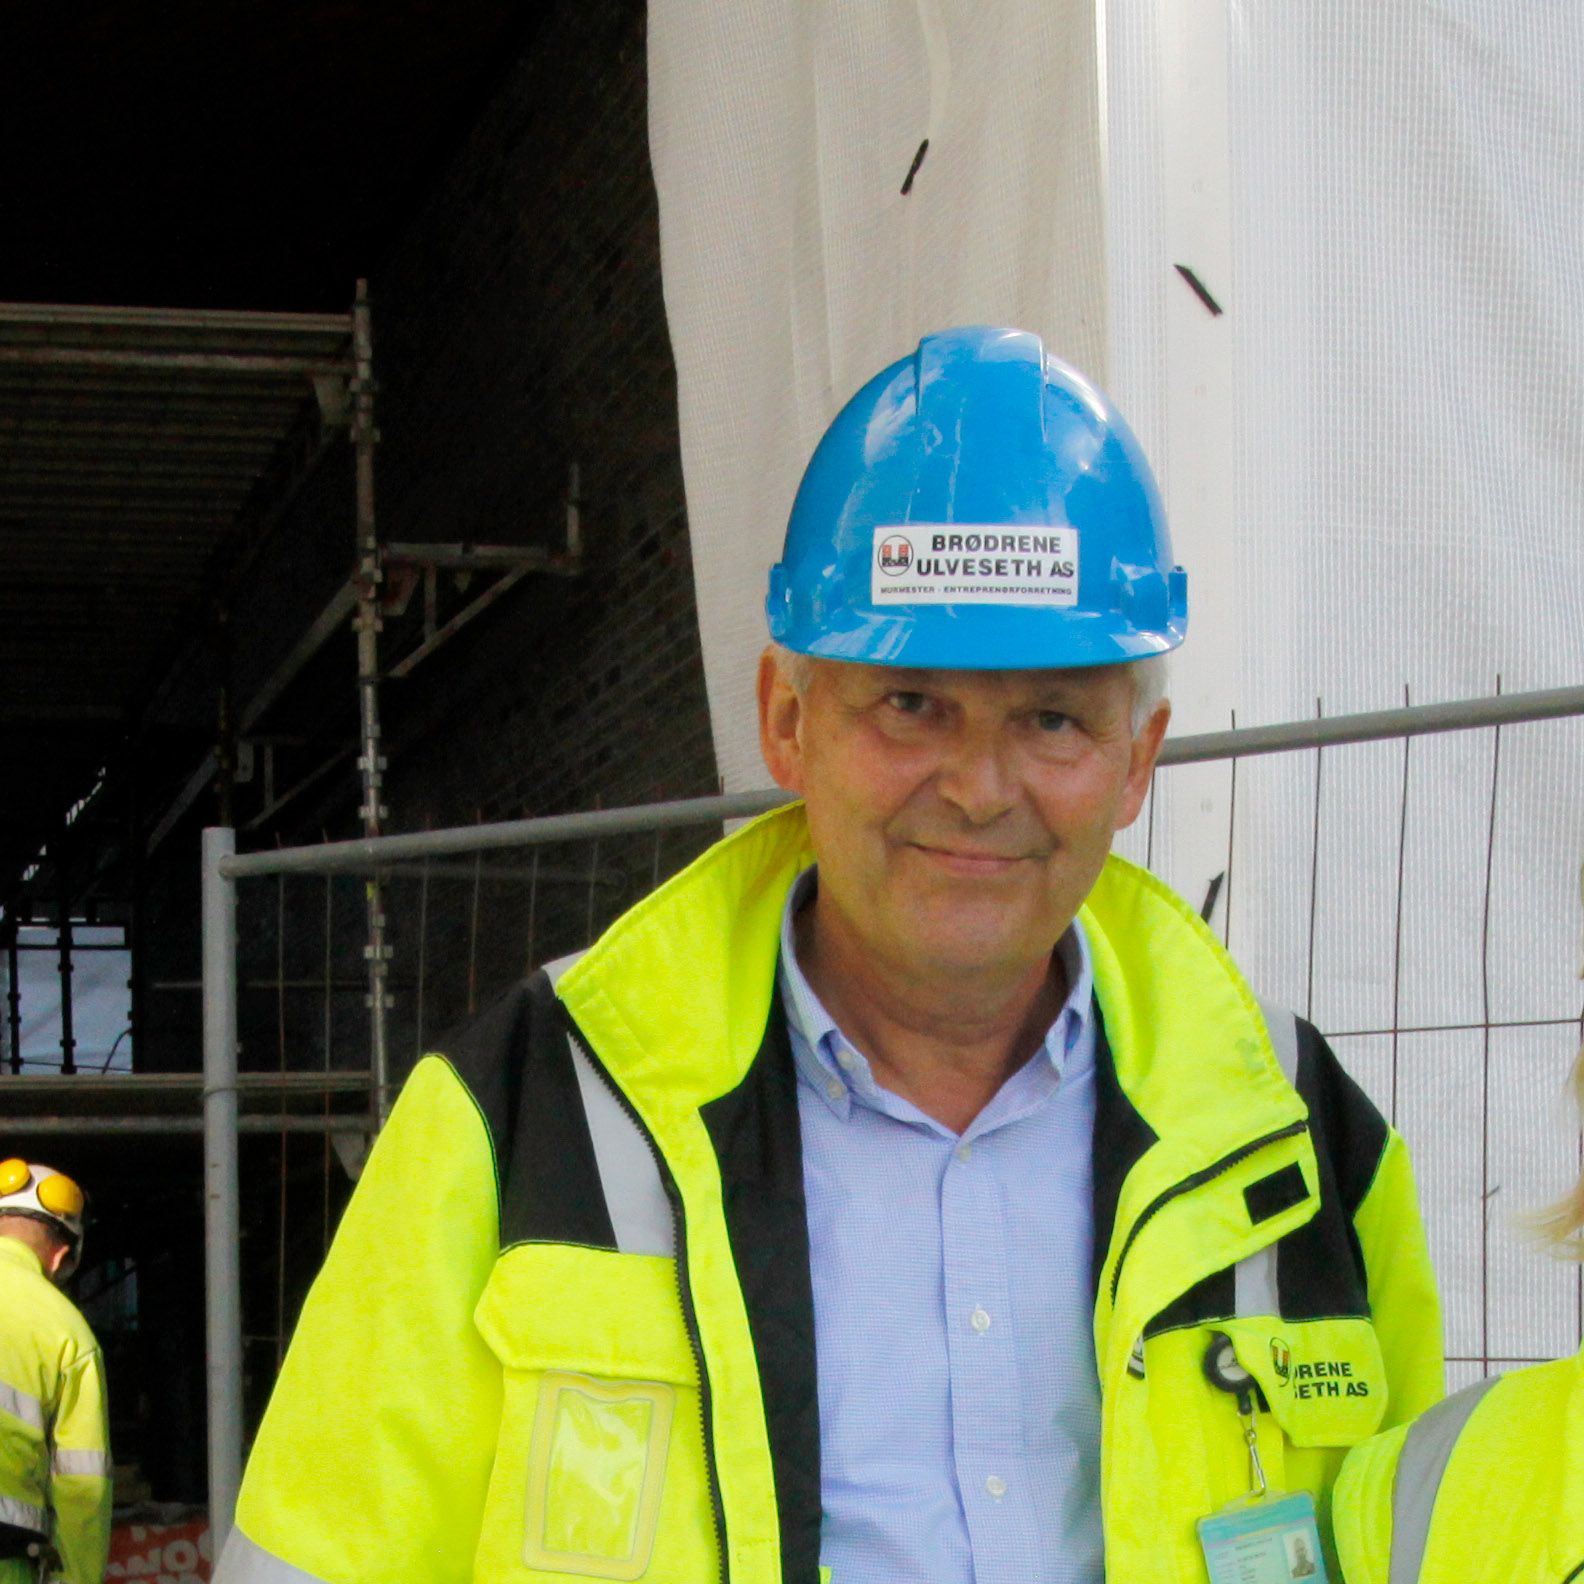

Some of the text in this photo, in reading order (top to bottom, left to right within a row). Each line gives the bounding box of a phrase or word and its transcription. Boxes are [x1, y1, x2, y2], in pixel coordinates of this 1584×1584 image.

[932, 534, 1062, 554] BRØDRENE
[916, 558, 1074, 578] ULVESETH AS
[1295, 1362, 1352, 1379] RENE
[1295, 1382, 1368, 1399] ETH AS
